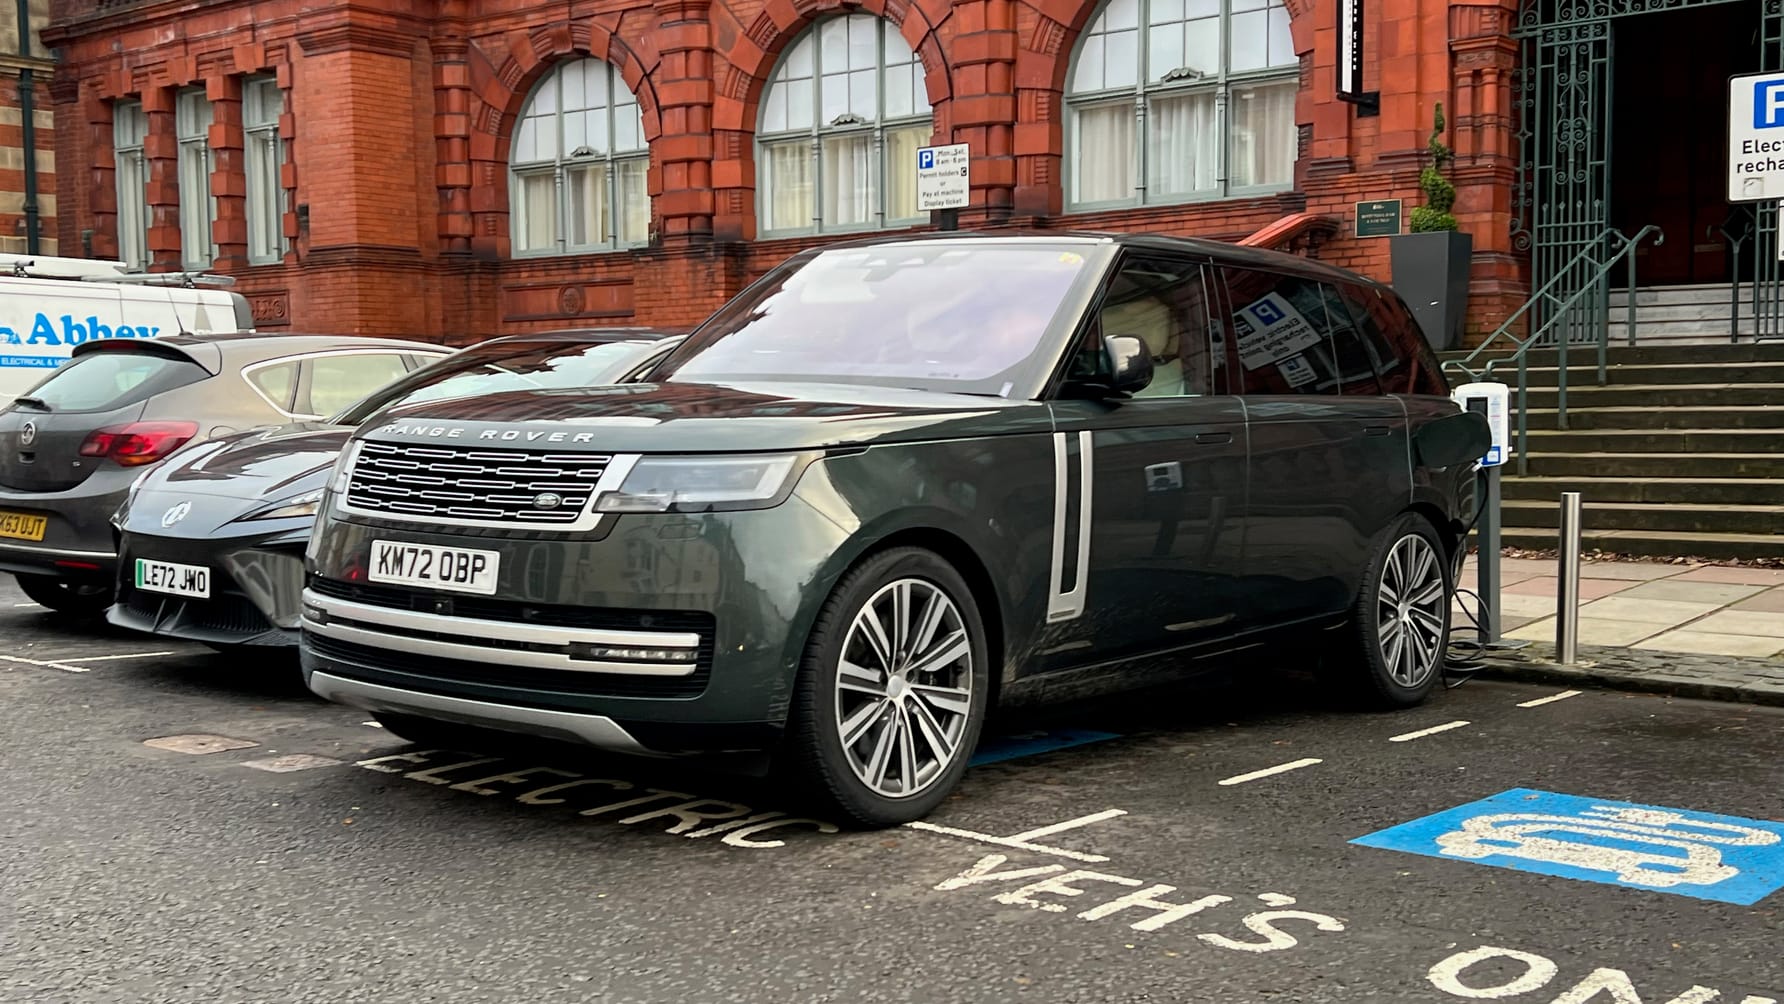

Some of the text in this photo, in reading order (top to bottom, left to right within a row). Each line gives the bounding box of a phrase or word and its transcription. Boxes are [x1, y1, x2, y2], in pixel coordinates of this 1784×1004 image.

[1742, 139, 1784, 154] Elec
[922, 152, 932, 168] P
[1, 357, 45, 366] ELECTRICAL
[381, 424, 595, 443] RANGE ROVER
[21, 516, 44, 536] UJT
[378, 545, 486, 584] KM72 OBP
[144, 563, 206, 592] LE72 JWO
[354, 749, 839, 848] ELECTRIC
[933, 854, 1345, 952] VEH'S
